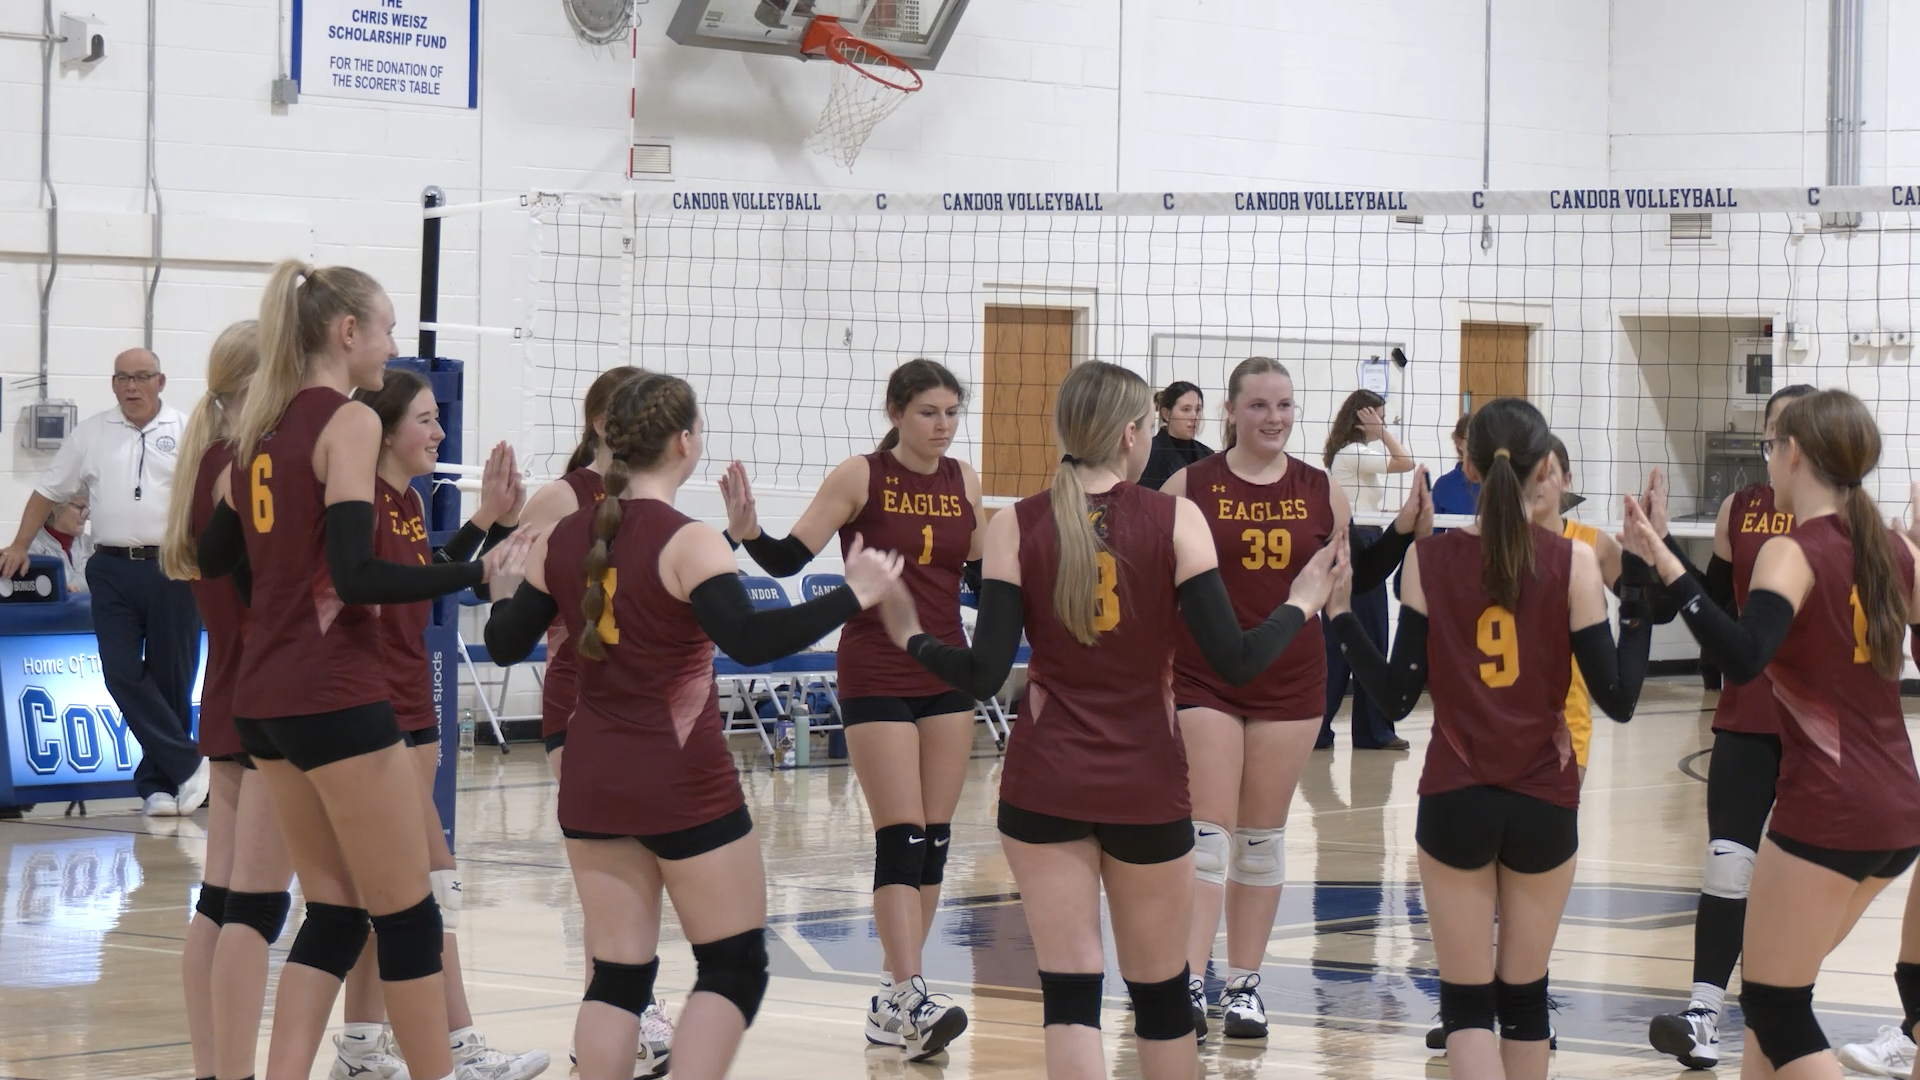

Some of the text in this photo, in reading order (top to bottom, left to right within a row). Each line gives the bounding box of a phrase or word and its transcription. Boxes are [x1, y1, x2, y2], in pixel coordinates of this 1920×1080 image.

[352, 9, 428, 29] CHRIS WEISZ
[328, 25, 447, 49] SCHOLARSHIP FUND
[330, 56, 443, 78] FOR THE DONATION OF
[332, 73, 440, 95] THE SCORER'S TABLE
[673, 192, 821, 211] CANDOR VOLLEYBALL
[876, 193, 888, 210] C
[943, 192, 1103, 211] CANDOR VOLLEYBALL
[1163, 193, 1175, 210] C
[1235, 191, 1408, 211] CANDOR VOLLEYBALL
[1472, 191, 1484, 209] C
[1550, 187, 1737, 209] CANDOR VOLLEYBALL
[1807, 187, 1820, 206] C
[1891, 185, 1920, 206] CA
[251, 453, 275, 533] 6
[883, 489, 962, 517] EAGLES
[1218, 499, 1308, 522] EAGLES
[918, 524, 934, 565] 1
[1241, 528, 1292, 570] 39
[13, 580, 36, 592] BONUS
[1476, 605, 1520, 688] 9
[23, 656, 65, 675] Home
[69, 652, 86, 678] Of
[432, 651, 444, 702] sports
[19, 684, 133, 776] COY
